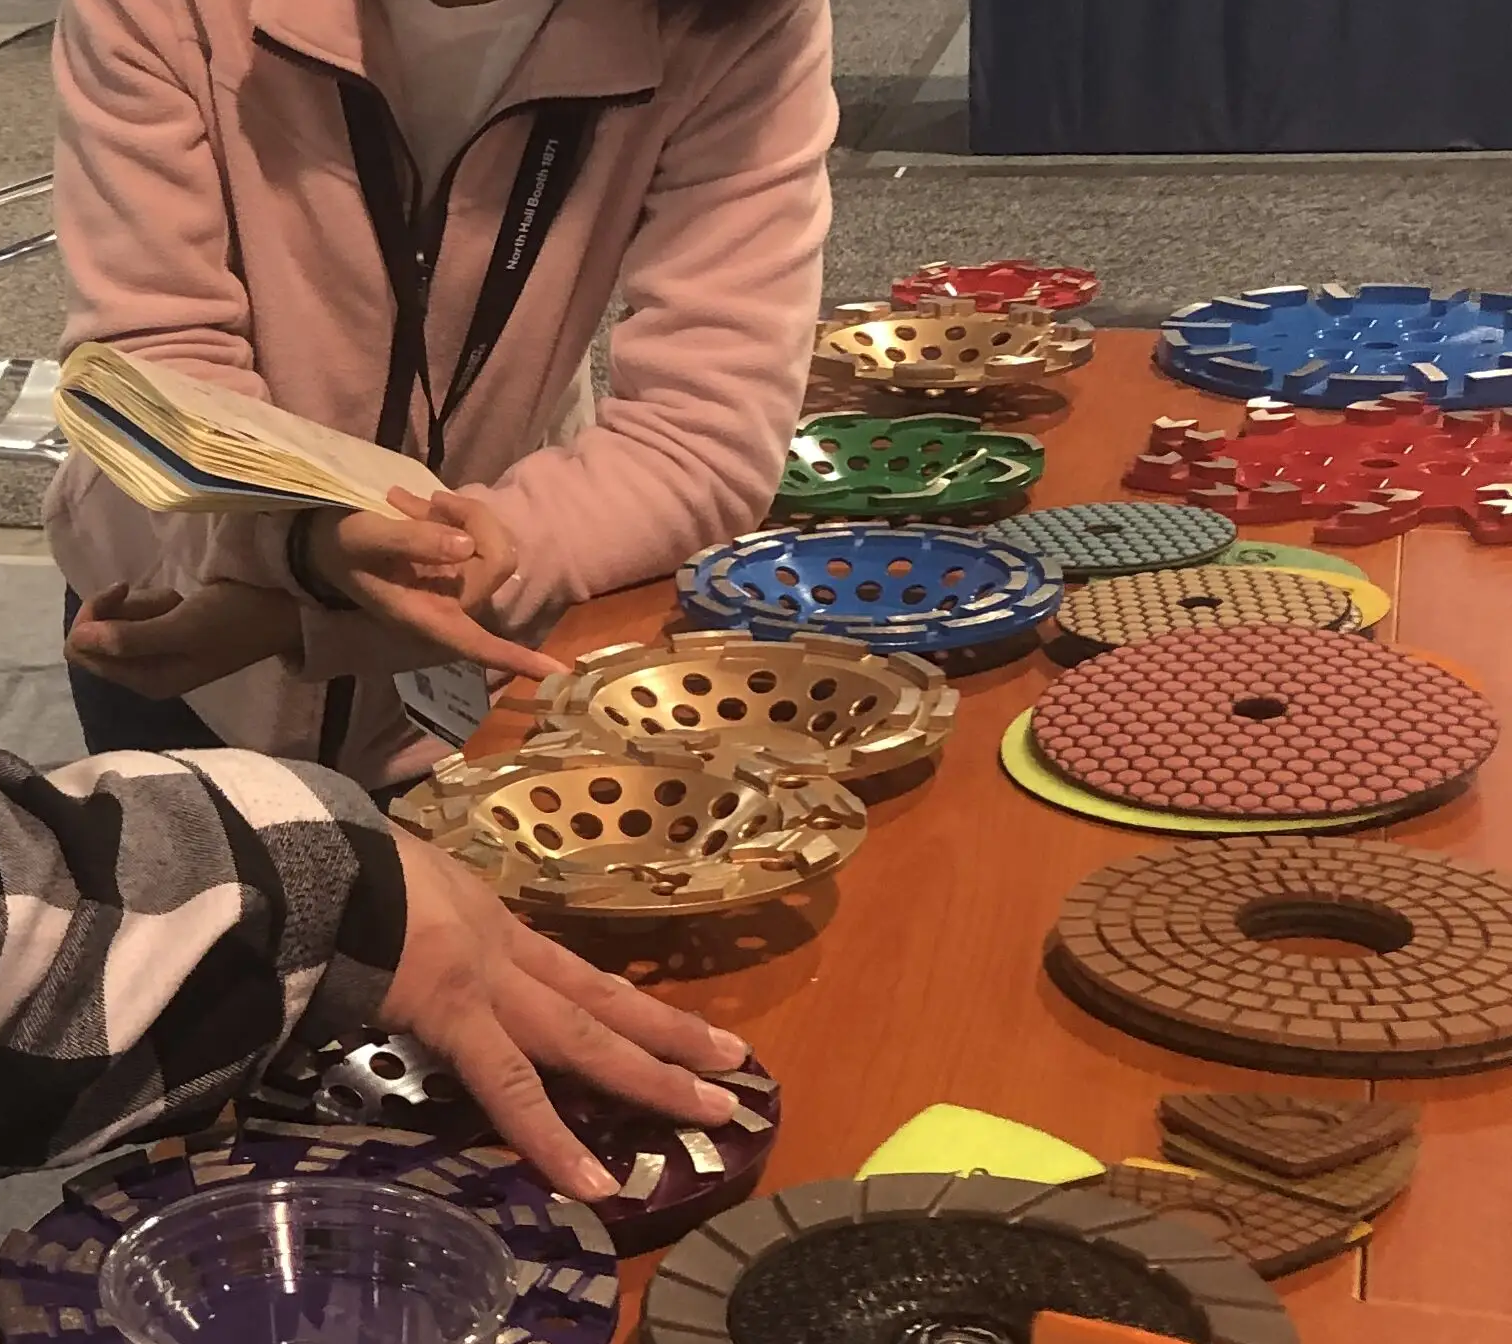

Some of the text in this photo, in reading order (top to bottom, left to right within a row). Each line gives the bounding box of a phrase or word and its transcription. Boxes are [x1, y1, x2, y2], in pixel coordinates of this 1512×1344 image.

[506, 138, 559, 270] North Hall Booth 1871
